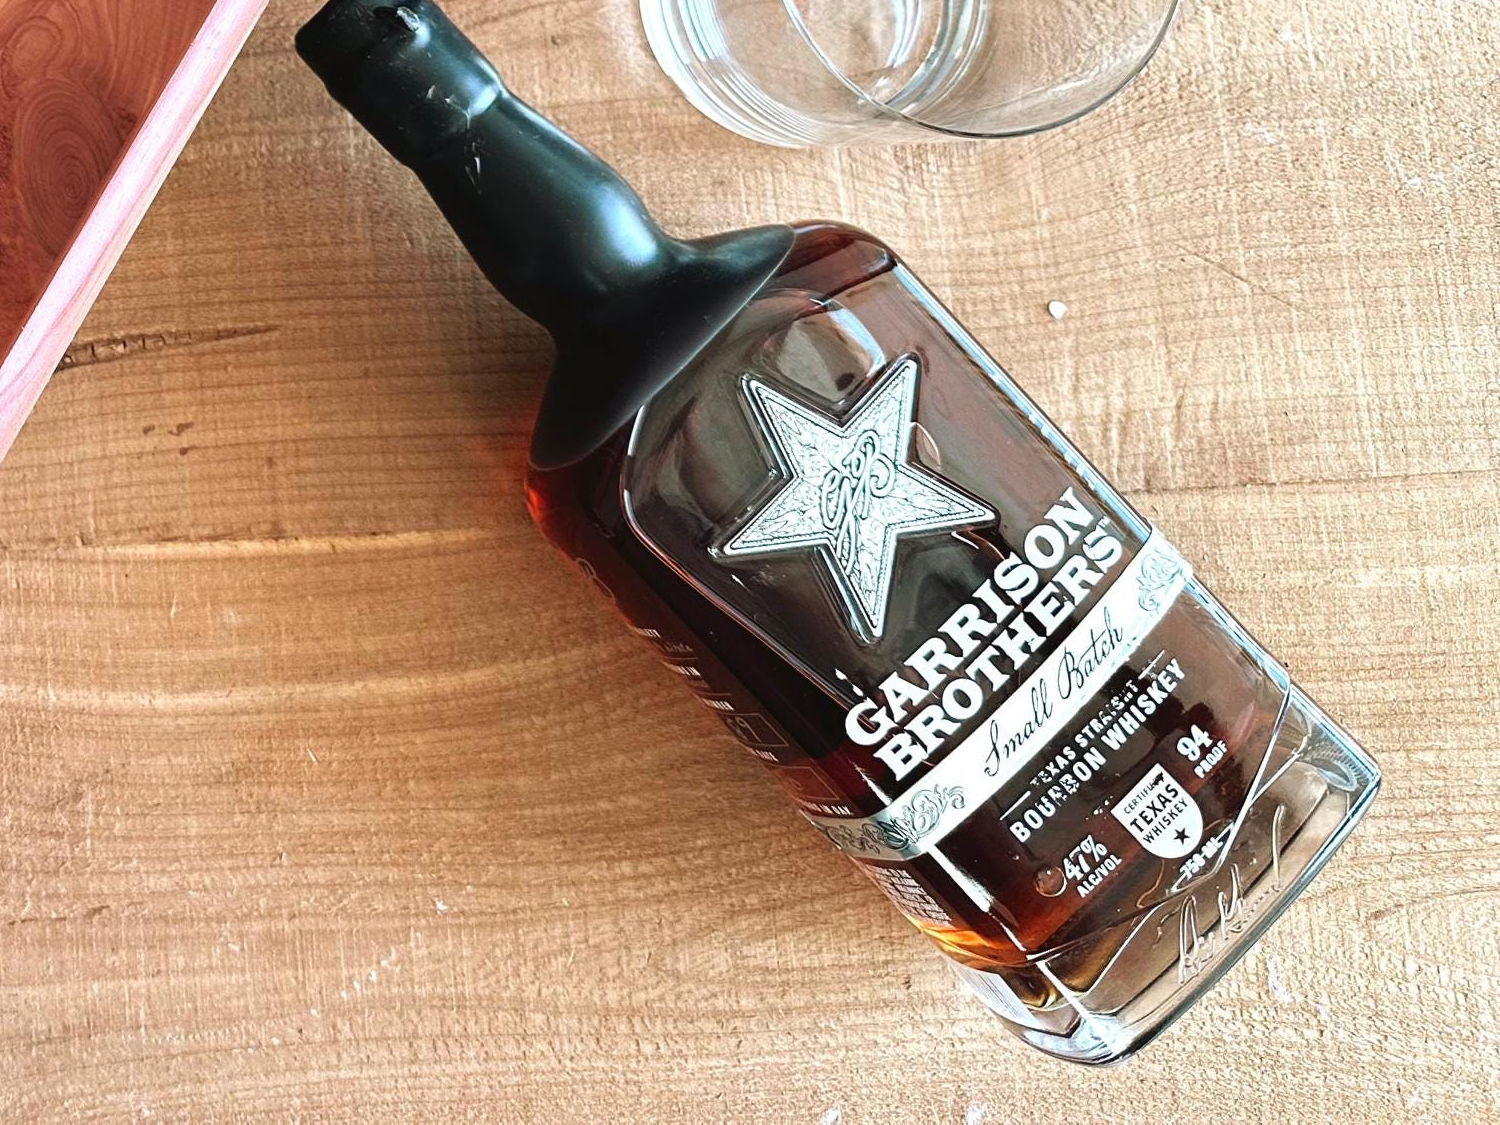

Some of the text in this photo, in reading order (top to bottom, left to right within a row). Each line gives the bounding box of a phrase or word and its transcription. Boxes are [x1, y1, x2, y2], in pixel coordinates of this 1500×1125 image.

[845, 486, 1094, 746] GARRISON
[983, 606, 1124, 777] Small Batch
[1008, 657, 1186, 844] BOURBON WHISKEY
[1176, 723, 1213, 763] 94
[1193, 739, 1229, 779] PROOF
[1029, 745, 1077, 792] TEXAS
[1123, 771, 1165, 814] CERTIFI
[1129, 782, 1180, 834] TEXAS
[1142, 797, 1189, 845] WHISKEY
[1062, 834, 1109, 883] 47%
[1075, 853, 1123, 899] ALC/VOL
